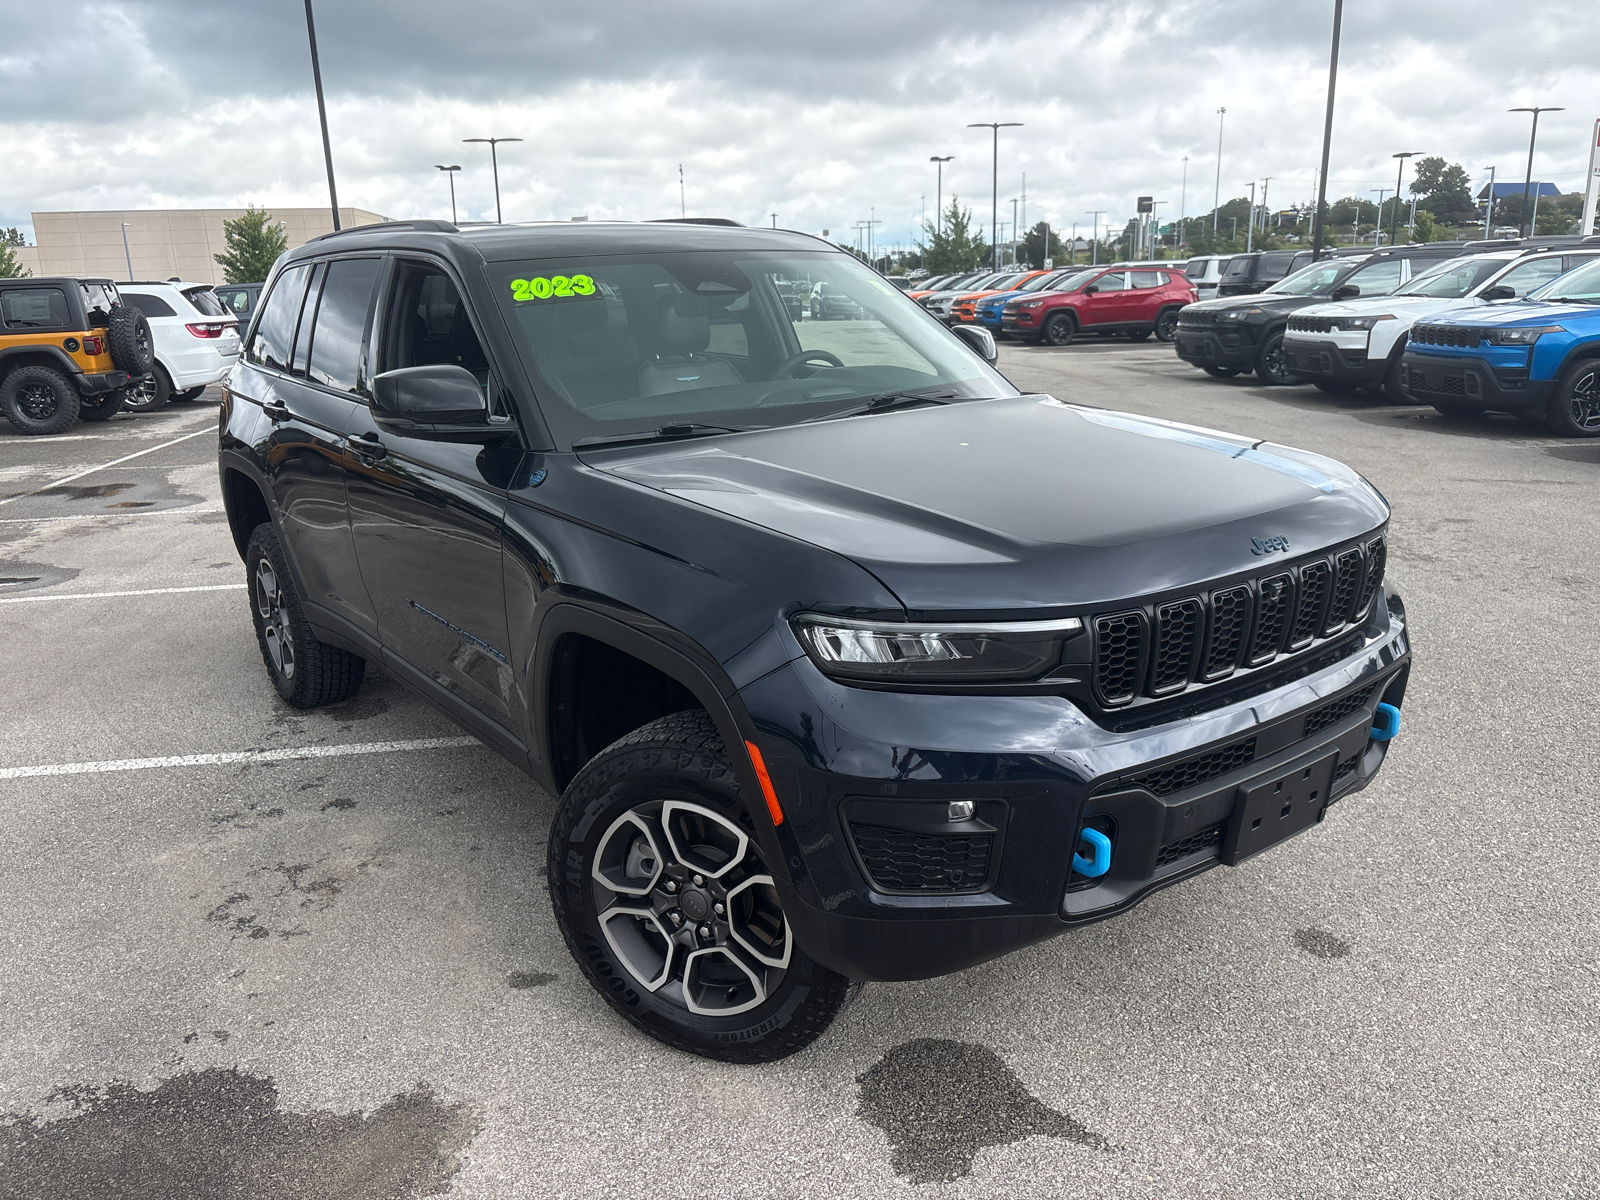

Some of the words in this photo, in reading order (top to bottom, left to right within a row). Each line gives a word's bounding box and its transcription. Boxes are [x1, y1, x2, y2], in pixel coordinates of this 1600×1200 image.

[511, 274, 596, 302] 2023
[1250, 535, 1290, 557] Jeep
[714, 1015, 781, 1042] TERRITORY
